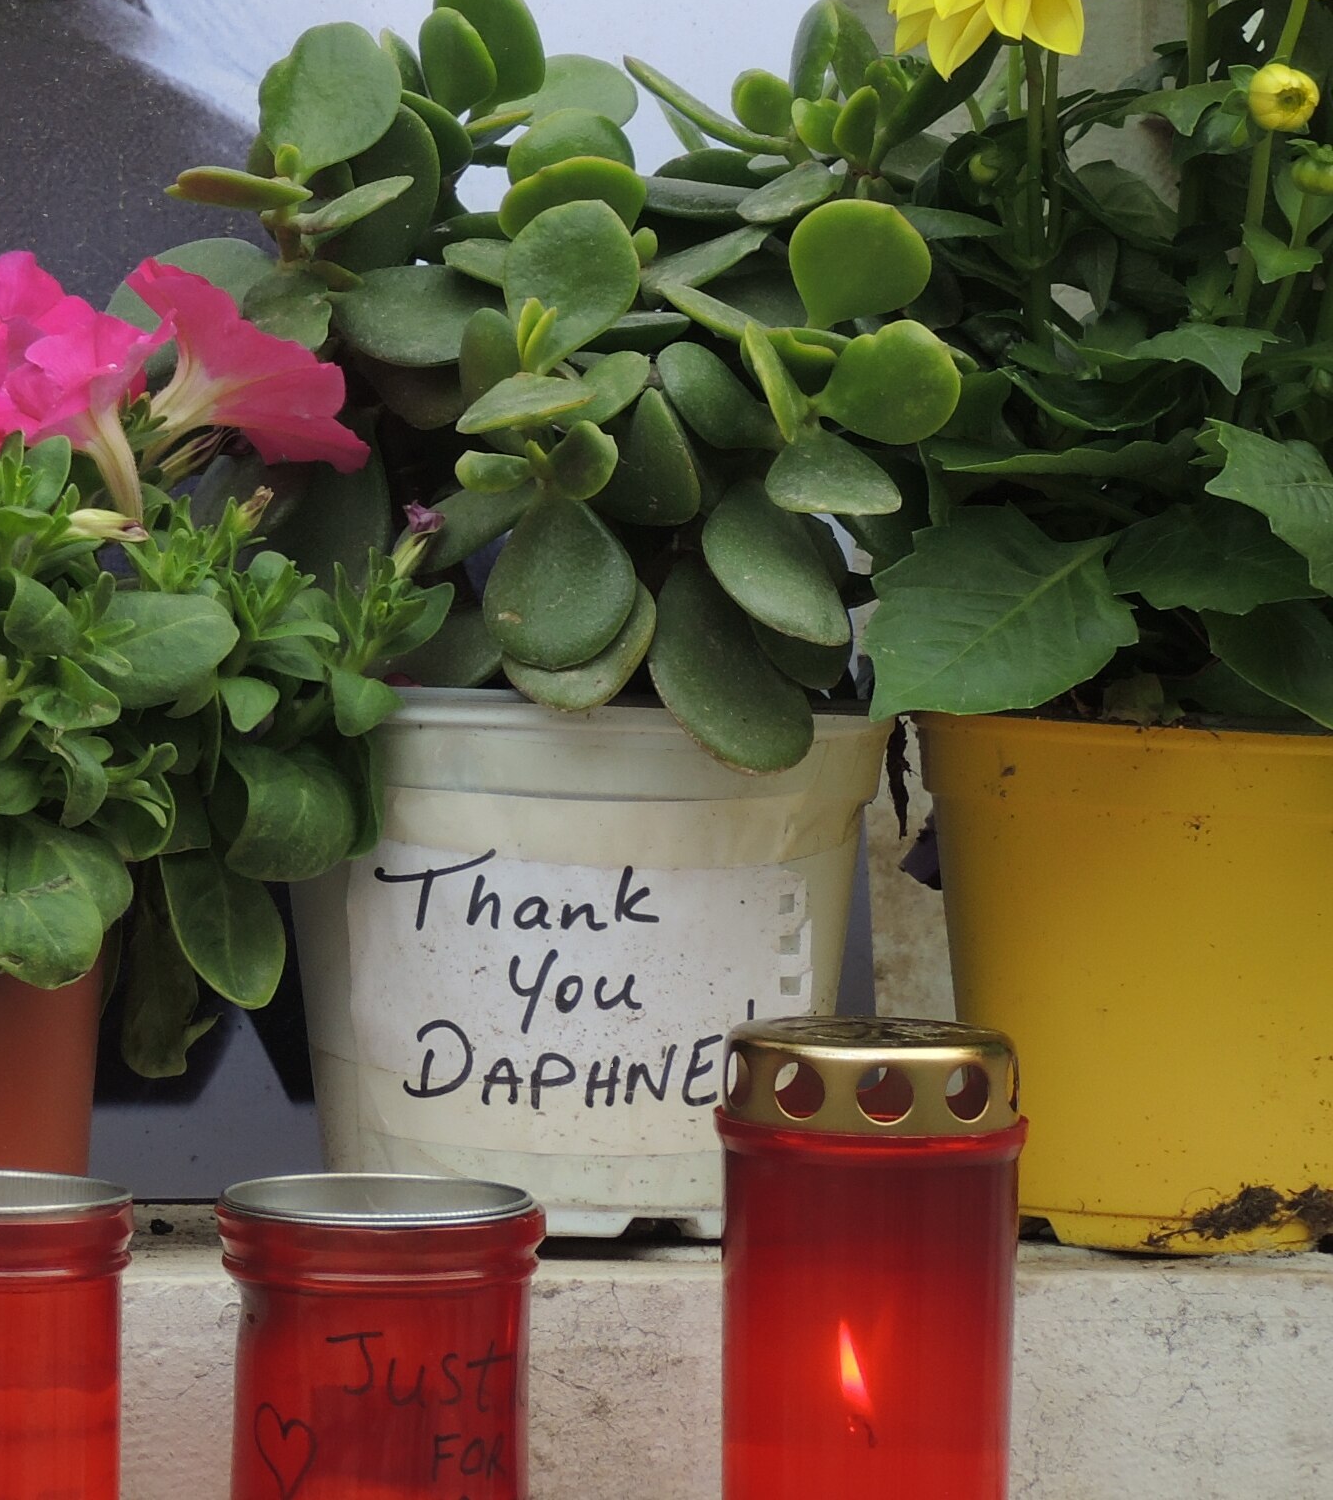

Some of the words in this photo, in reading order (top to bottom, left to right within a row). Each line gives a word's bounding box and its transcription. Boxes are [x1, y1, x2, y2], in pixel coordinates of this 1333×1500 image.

[374, 848, 660, 931] Thank
[508, 949, 643, 1034] You
[402, 998, 755, 1110] DAPHNE
